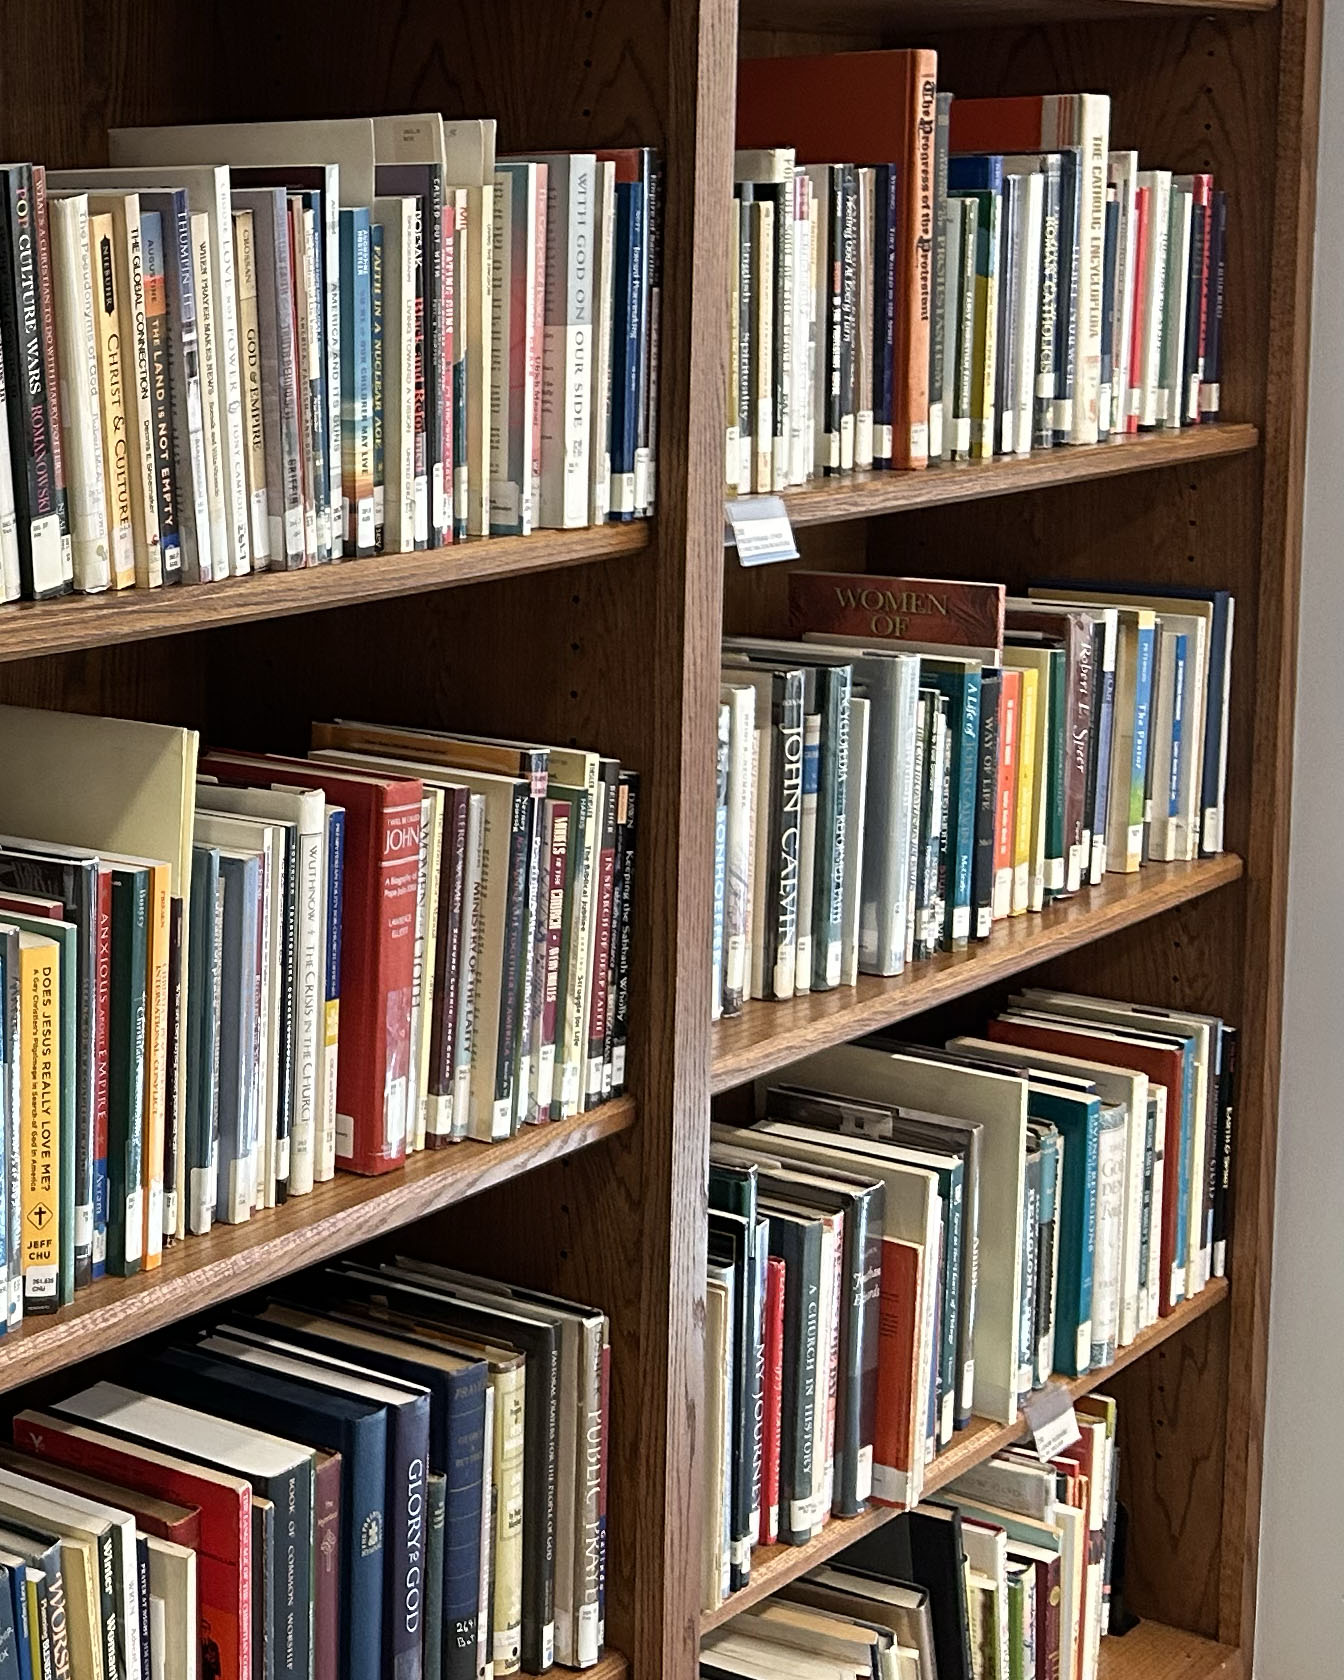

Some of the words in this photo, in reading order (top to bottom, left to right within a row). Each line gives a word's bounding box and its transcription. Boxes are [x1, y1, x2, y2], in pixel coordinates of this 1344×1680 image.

[1092, 136, 1102, 161] THE
[15, 188, 28, 227] POP
[578, 173, 587, 225] WITH
[1092, 166, 1103, 231] CATHOLIC
[576, 234, 586, 282] GOD
[18, 234, 36, 332] CULTURE
[575, 291, 585, 320] ON
[1089, 236, 1101, 338] ENCYCLOPEDIA
[26, 338, 42, 395] WARS
[107, 333, 121, 409] CHRIST
[575, 331, 584, 374] OUR
[113, 415, 124, 432] &
[574, 383, 583, 428] SIDE
[31, 403, 51, 513] ROMANOWSKI
[114, 439, 129, 527] CULTURE
[835, 588, 947, 615] WOMEN
[871, 615, 908, 637] OF
[1080, 643, 1092, 695] Robert
[779, 723, 802, 812] JOHN
[1072, 725, 1089, 774] Speer
[384, 830, 419, 854] JOHN
[43, 967, 51, 1006] DOES
[43, 1012, 51, 1057] JESUS
[42, 1061, 51, 1115] REALLY
[42, 1121, 51, 1160] LOVE
[41, 1164, 51, 1192] ME?
[27, 1239, 52, 1250] JEFF
[29, 1251, 51, 1261] CHU
[806, 1301, 817, 1371] CHURCH
[755, 1344, 765, 1388] MY
[806, 1378, 814, 1395] IN
[751, 1392, 764, 1510] JOURNEY
[802, 1400, 814, 1475] HISTORY
[287, 1478, 296, 1518] BOOK
[407, 1459, 422, 1548] GLORY
[287, 1524, 296, 1538] OF
[287, 1545, 296, 1607] COMMON
[406, 1566, 420, 1632] GOD
[286, 1615, 295, 1671] WORSHIP
